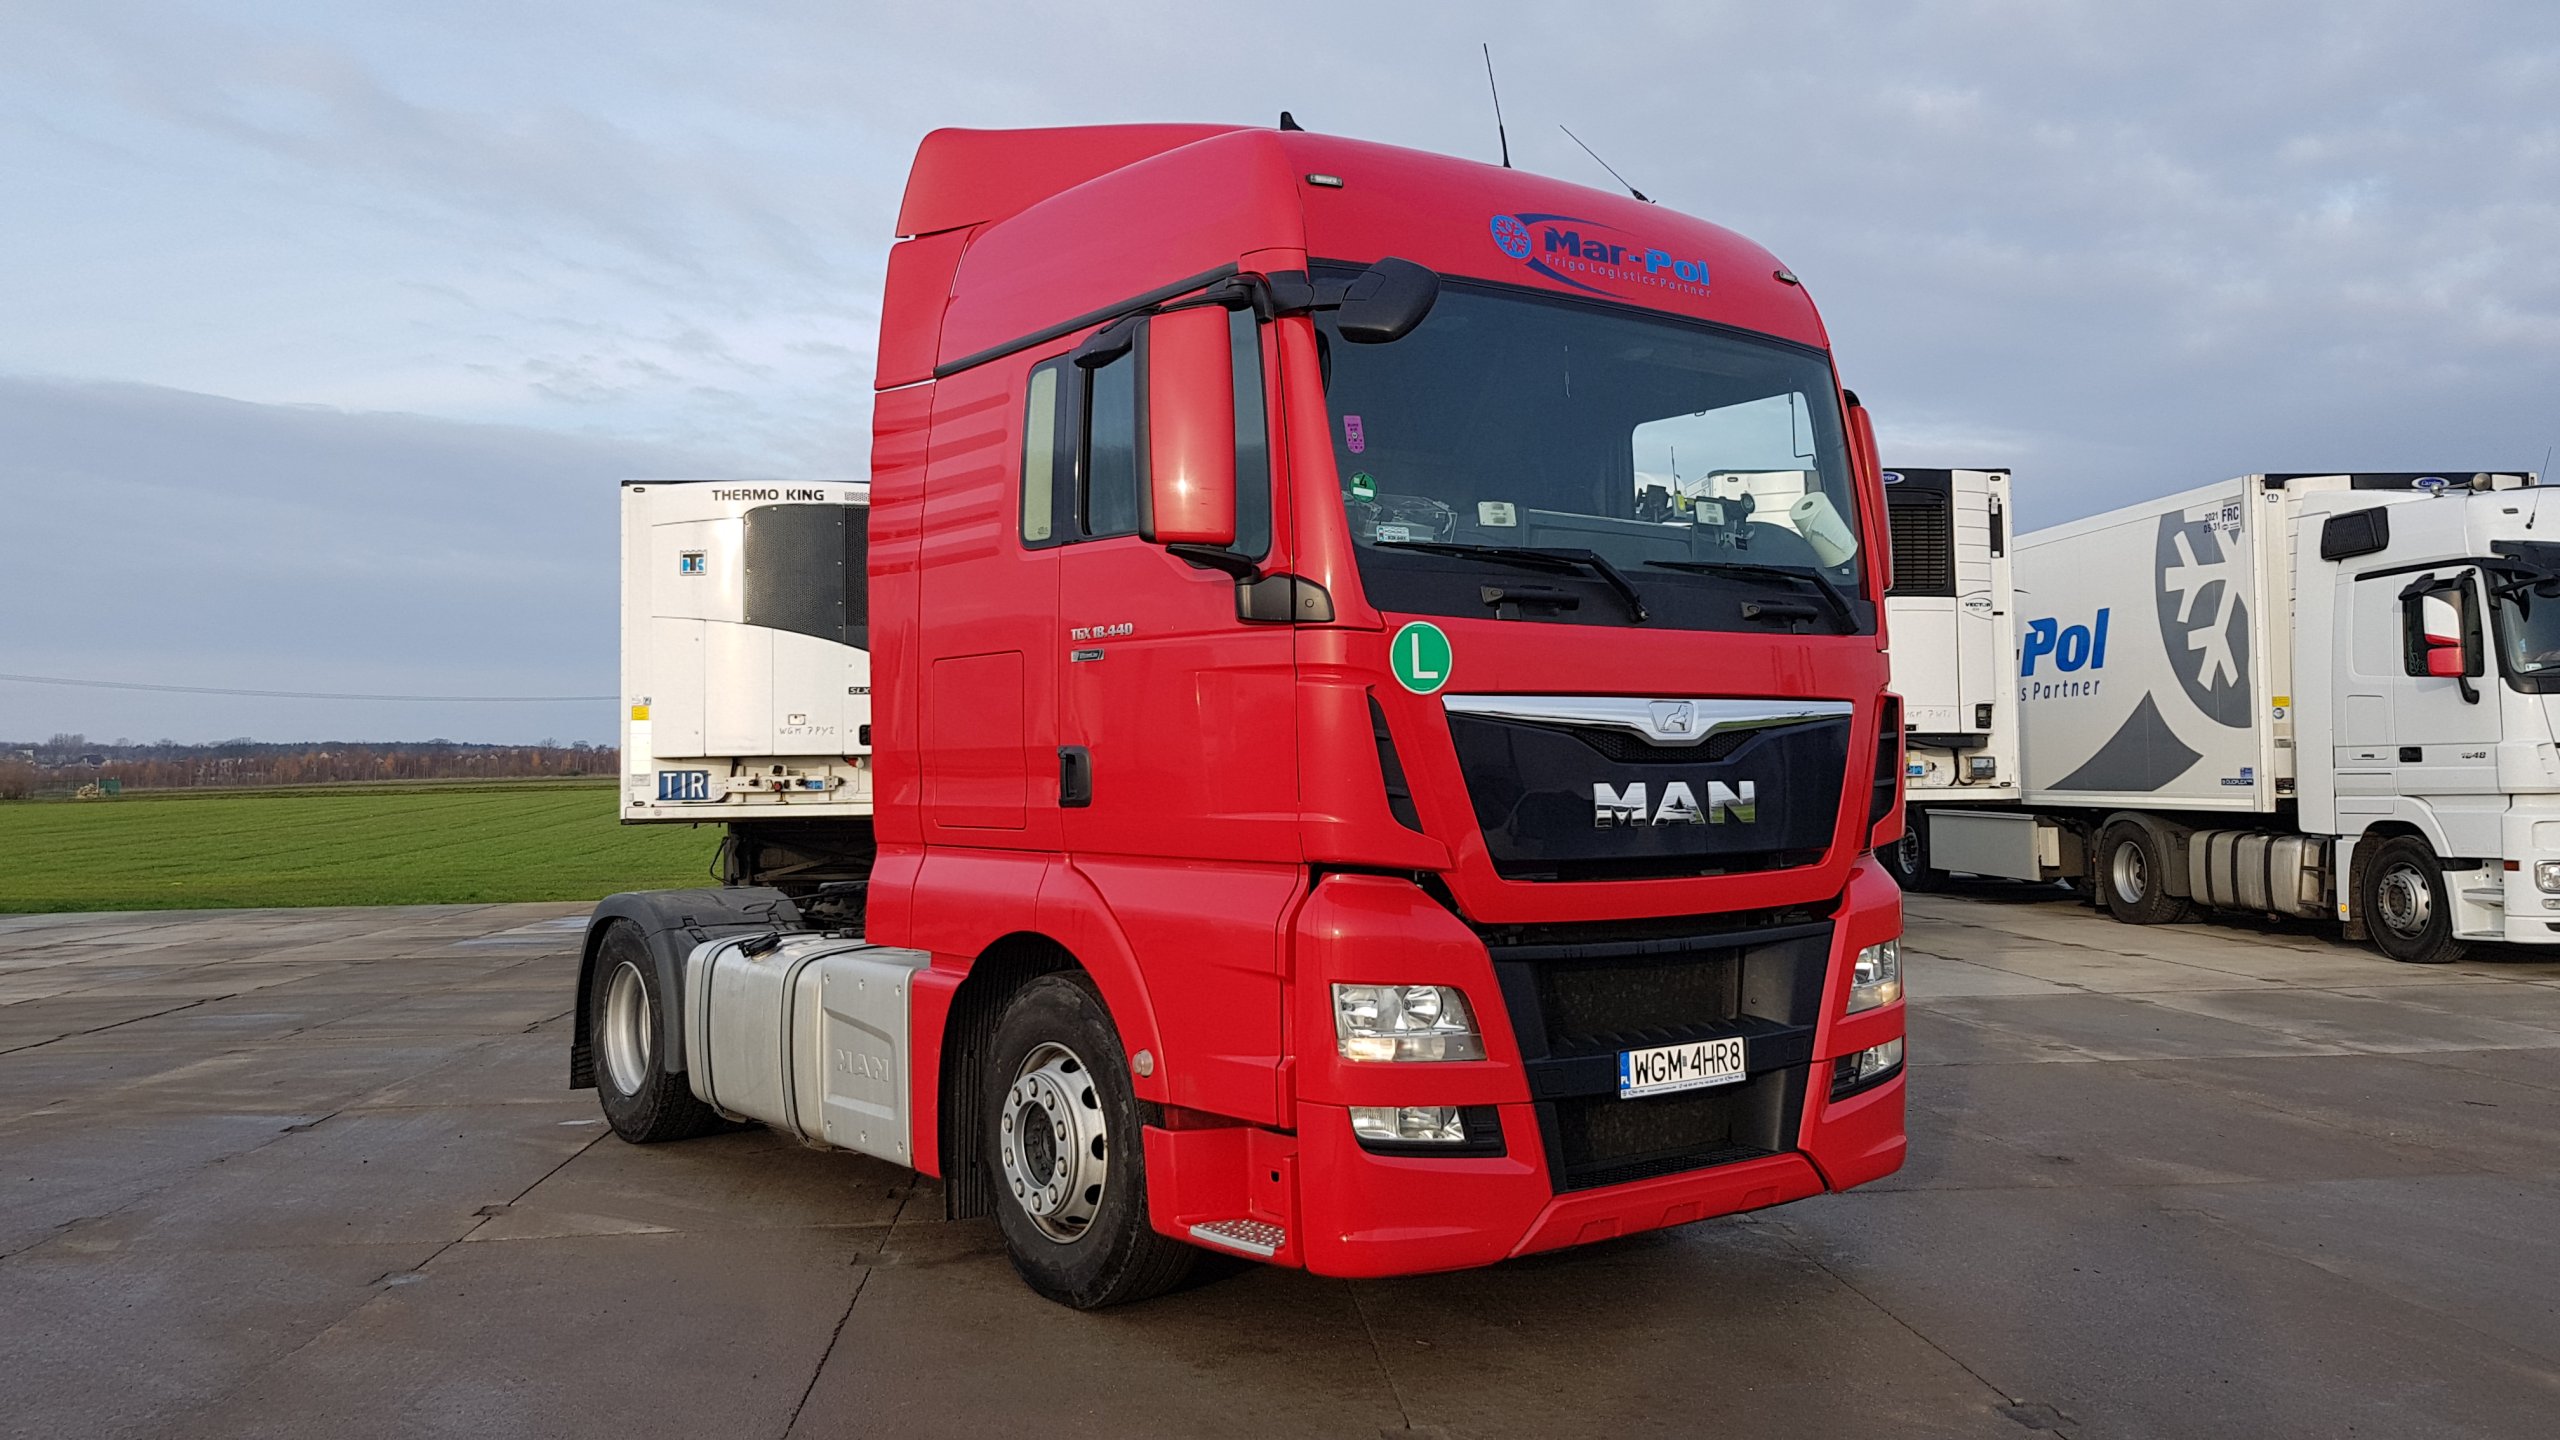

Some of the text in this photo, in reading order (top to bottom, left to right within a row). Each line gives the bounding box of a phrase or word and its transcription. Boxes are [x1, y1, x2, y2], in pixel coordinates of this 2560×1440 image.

[1544, 226, 1710, 286] Mar-Pol
[1545, 254, 1711, 298] Frigo Logistics Partner
[712, 489, 825, 501] THERMO KING
[1360, 474, 1368, 489] 4
[2221, 506, 2240, 523] FRC
[1071, 622, 1133, 640] TGX 18.440
[2017, 608, 2110, 677] Pol
[1411, 632, 1439, 679] L
[2033, 680, 2100, 700] Partner
[662, 772, 705, 799] TIR
[1593, 780, 1756, 828] MAN
[836, 1048, 889, 1082] MAN
[1634, 1041, 1741, 1085] WGM 4HR8
[1620, 1075, 1630, 1085] PL
